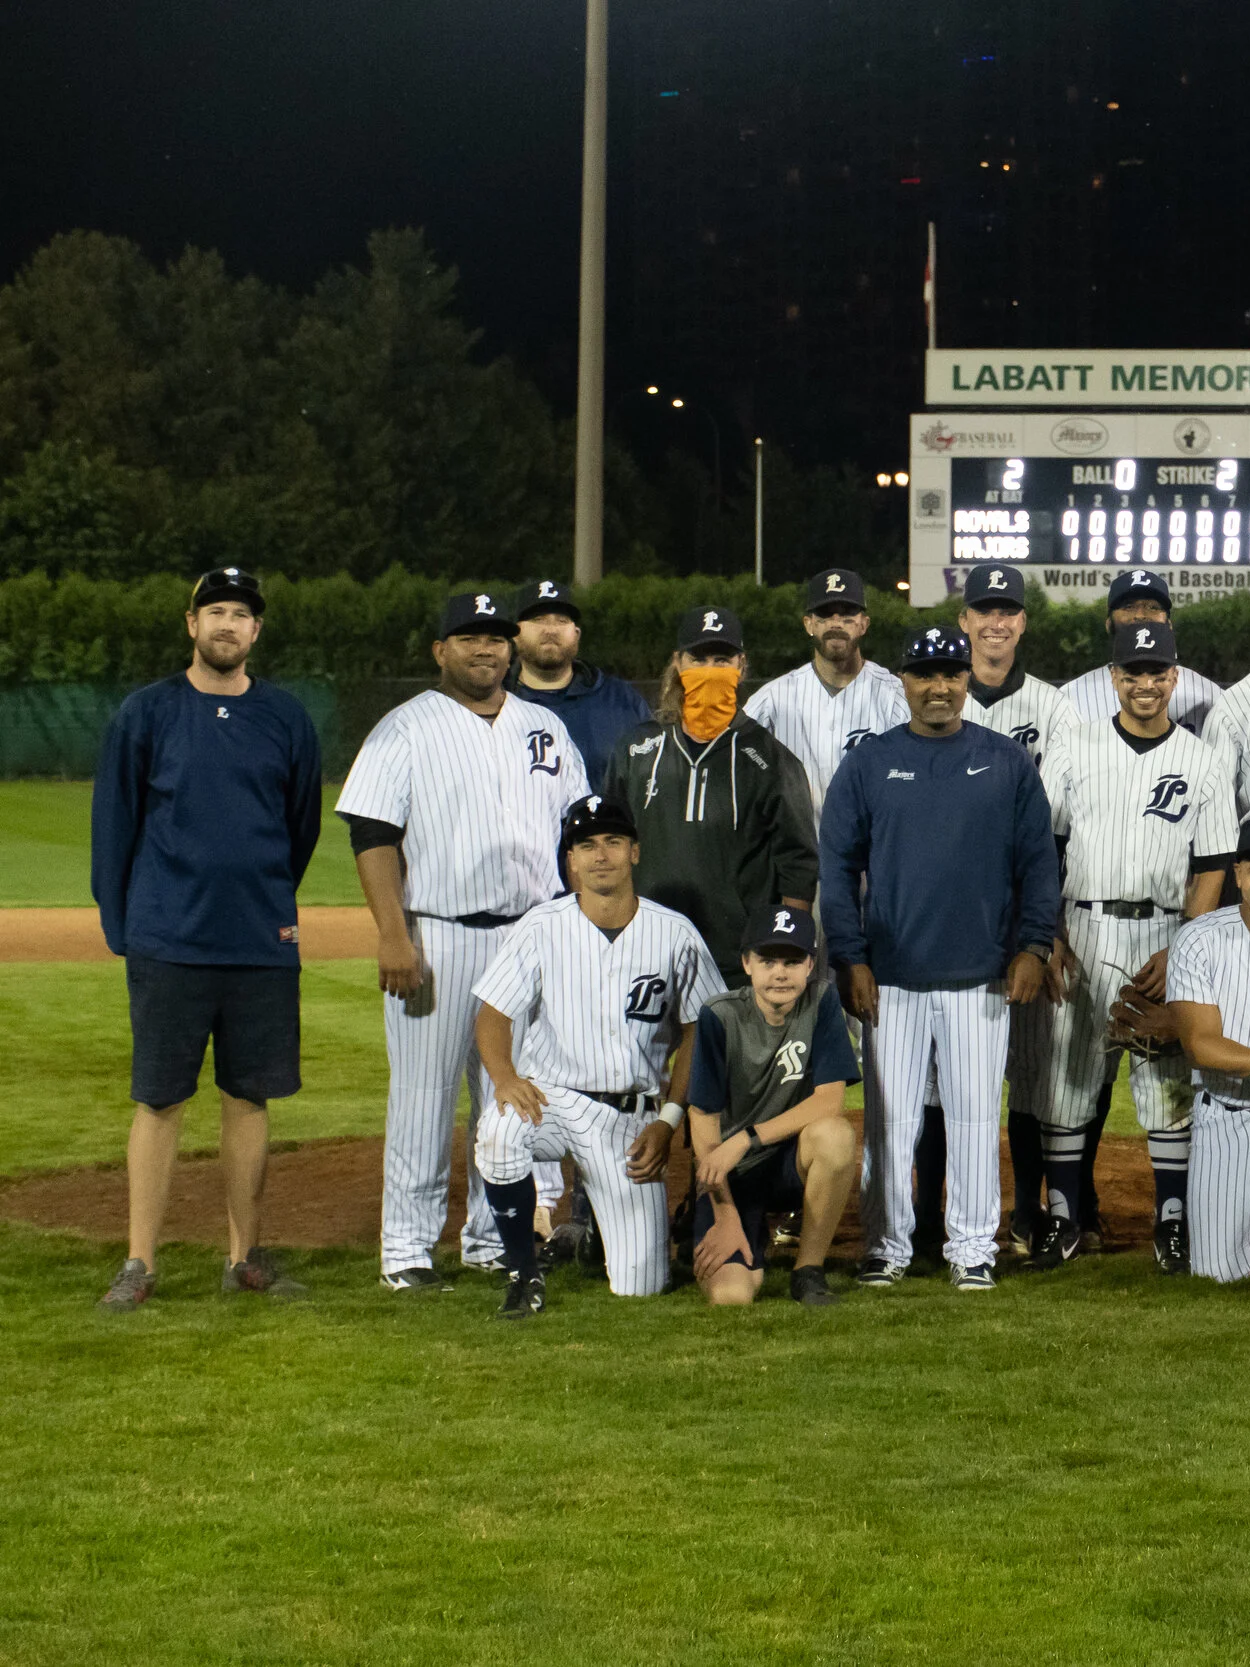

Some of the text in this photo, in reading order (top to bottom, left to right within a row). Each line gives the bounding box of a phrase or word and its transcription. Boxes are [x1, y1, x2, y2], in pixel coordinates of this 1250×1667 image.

[952, 365, 1094, 391] LABATT
[1003, 459, 1024, 490] 2
[1072, 465, 1114, 484] BALL
[1115, 459, 1136, 490] 0
[1157, 465, 1215, 485] STRIKE
[1216, 459, 1238, 490] 2
[985, 491, 999, 503] AT
[1067, 494, 1075, 508] 1
[1094, 494, 1102, 508] 2
[1120, 494, 1130, 508] 3
[1147, 494, 1155, 508] 4
[1174, 494, 1183, 508] 5
[1228, 494, 1236, 508] 7
[954, 510, 1029, 533] ROYALS
[1062, 510, 1080, 536] 0
[1089, 510, 1106, 536] 0
[1116, 510, 1133, 536] 0
[1142, 510, 1160, 536] 0
[1169, 510, 1187, 536] 0
[1196, 510, 1213, 536] 0
[1223, 510, 1240, 536] 0
[954, 536, 1029, 559] MAJORS
[1070, 537, 1079, 560] 1
[1088, 536, 1106, 562] 0
[1115, 536, 1133, 562] 2
[1142, 537, 1159, 562] 0
[1169, 537, 1186, 562] 0
[1196, 537, 1213, 562] 0
[1223, 537, 1240, 562] 0
[1044, 570, 1111, 587] World's
